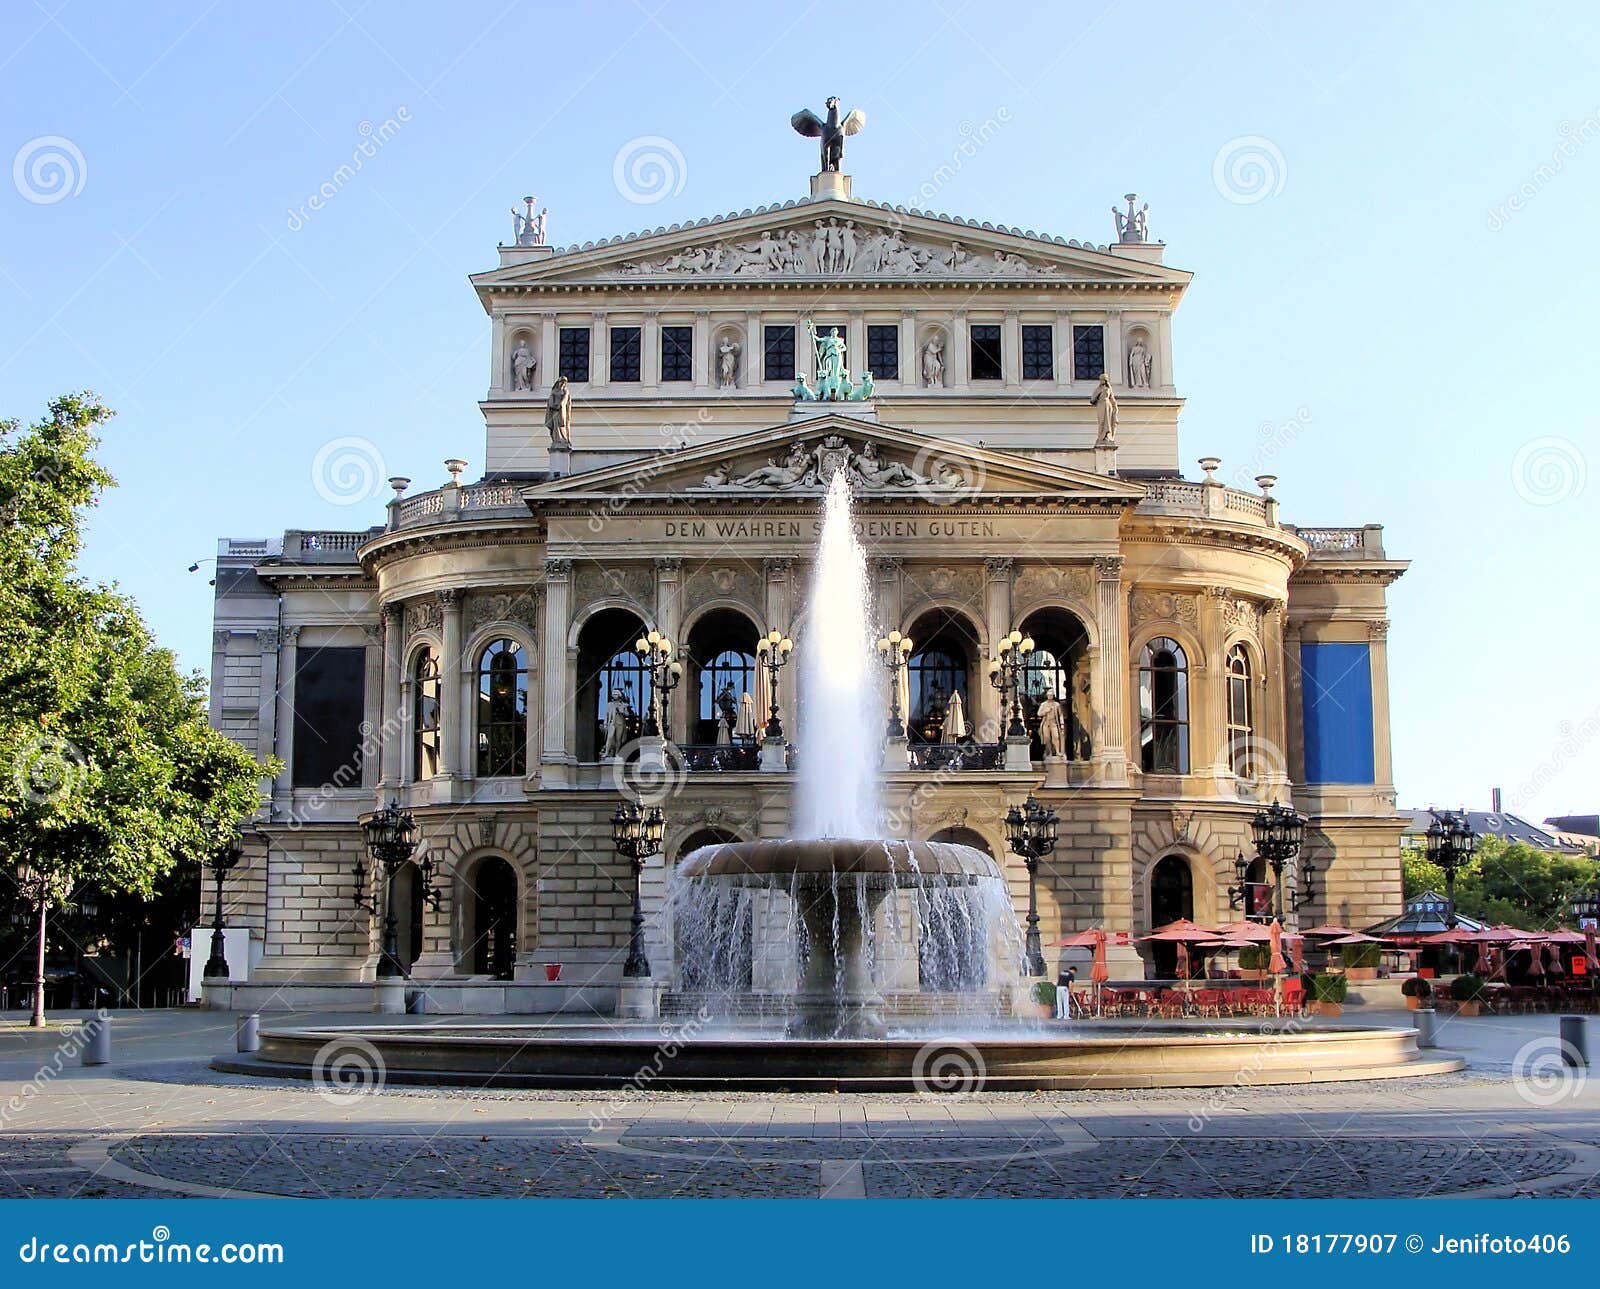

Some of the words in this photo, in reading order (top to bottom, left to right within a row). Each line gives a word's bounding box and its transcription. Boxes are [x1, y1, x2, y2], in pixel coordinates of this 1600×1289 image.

[665, 522, 706, 537] DEM
[716, 521, 800, 537] WAHREN
[812, 521, 917, 537] SOENEN
[928, 521, 1001, 536] GUTEN.
